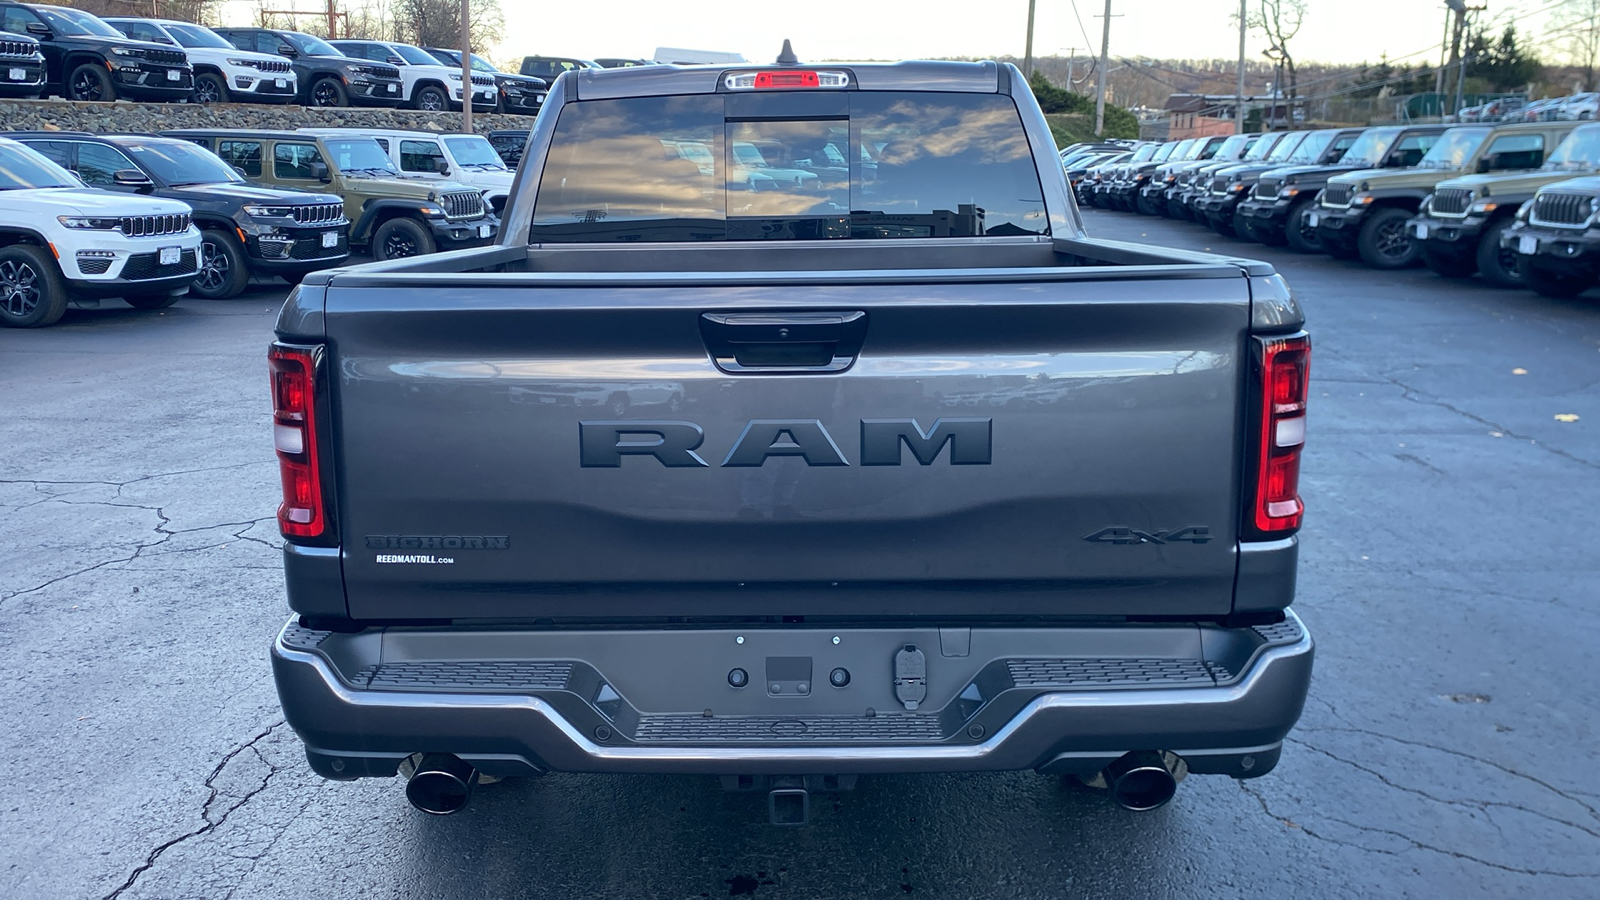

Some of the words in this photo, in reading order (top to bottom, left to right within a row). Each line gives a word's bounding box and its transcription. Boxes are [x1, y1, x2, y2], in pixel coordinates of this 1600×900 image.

[578, 418, 993, 468] RAM
[365, 534, 510, 549] BIGHORN
[376, 554, 454, 564] REEDMANTOLL.COM
